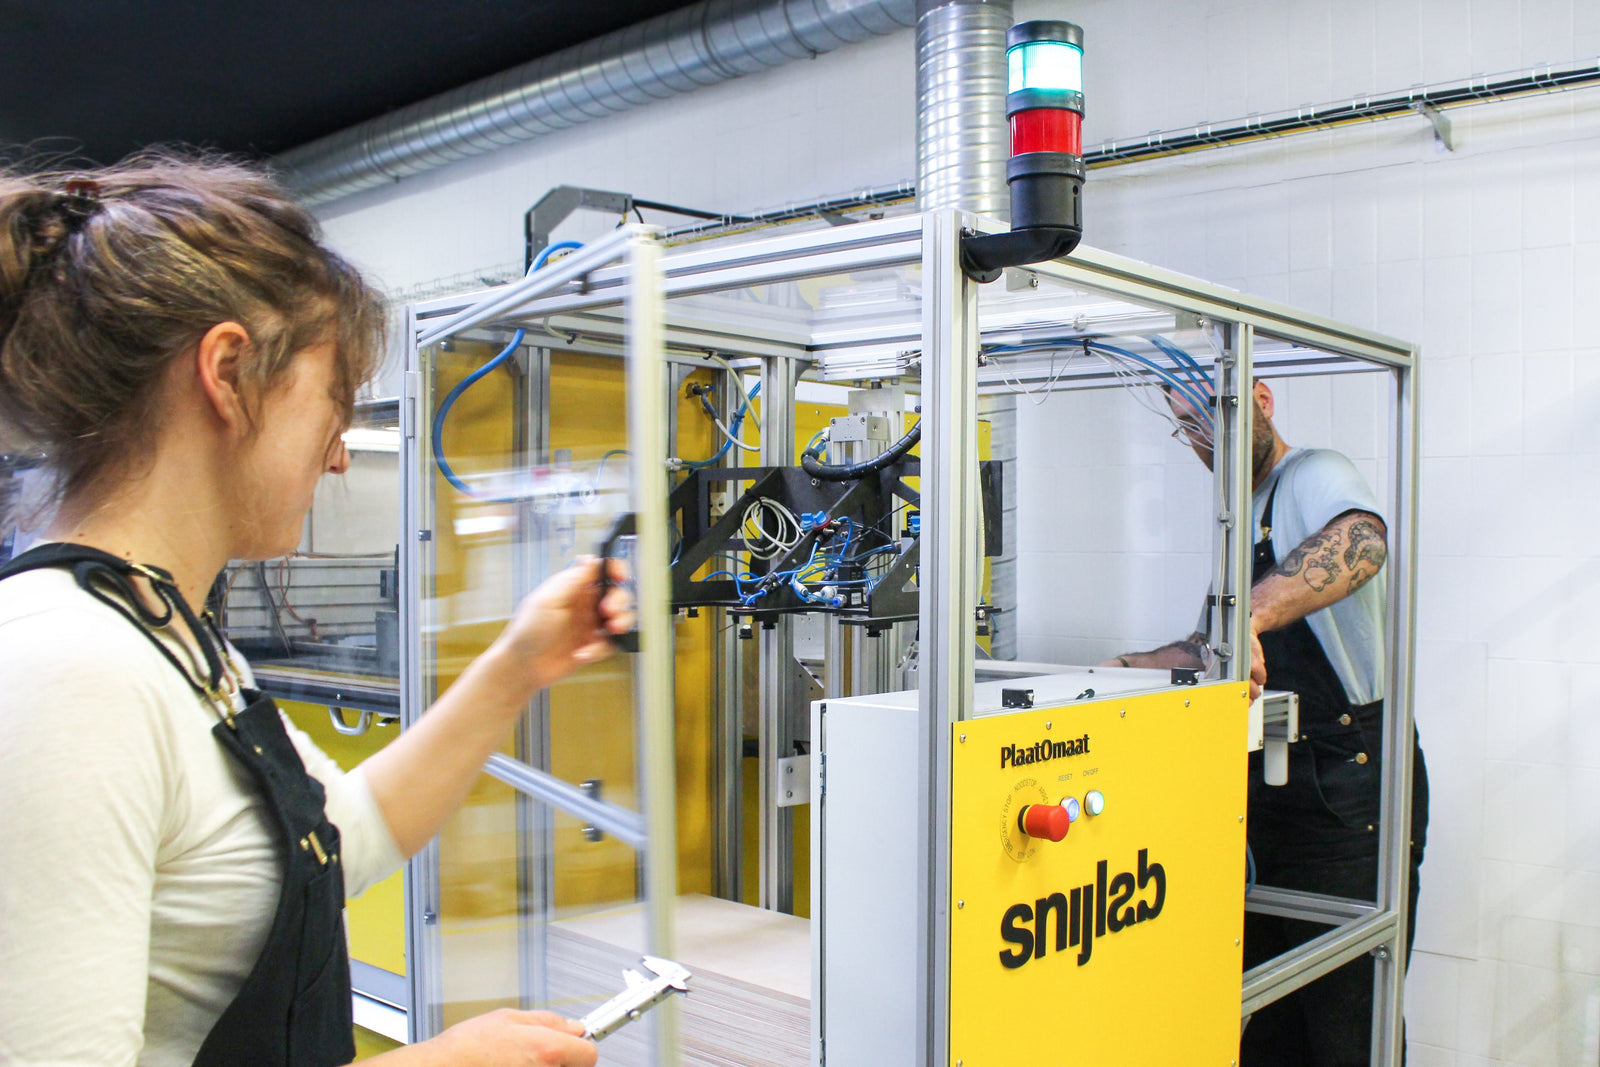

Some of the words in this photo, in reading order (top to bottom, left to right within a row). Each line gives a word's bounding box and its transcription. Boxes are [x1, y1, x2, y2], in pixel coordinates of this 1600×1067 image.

[1001, 734, 1090, 769] PlaatOmaat
[1058, 773, 1073, 782] RESET
[1003, 794, 1012, 813] STOP
[999, 848, 1167, 969] snijlab
